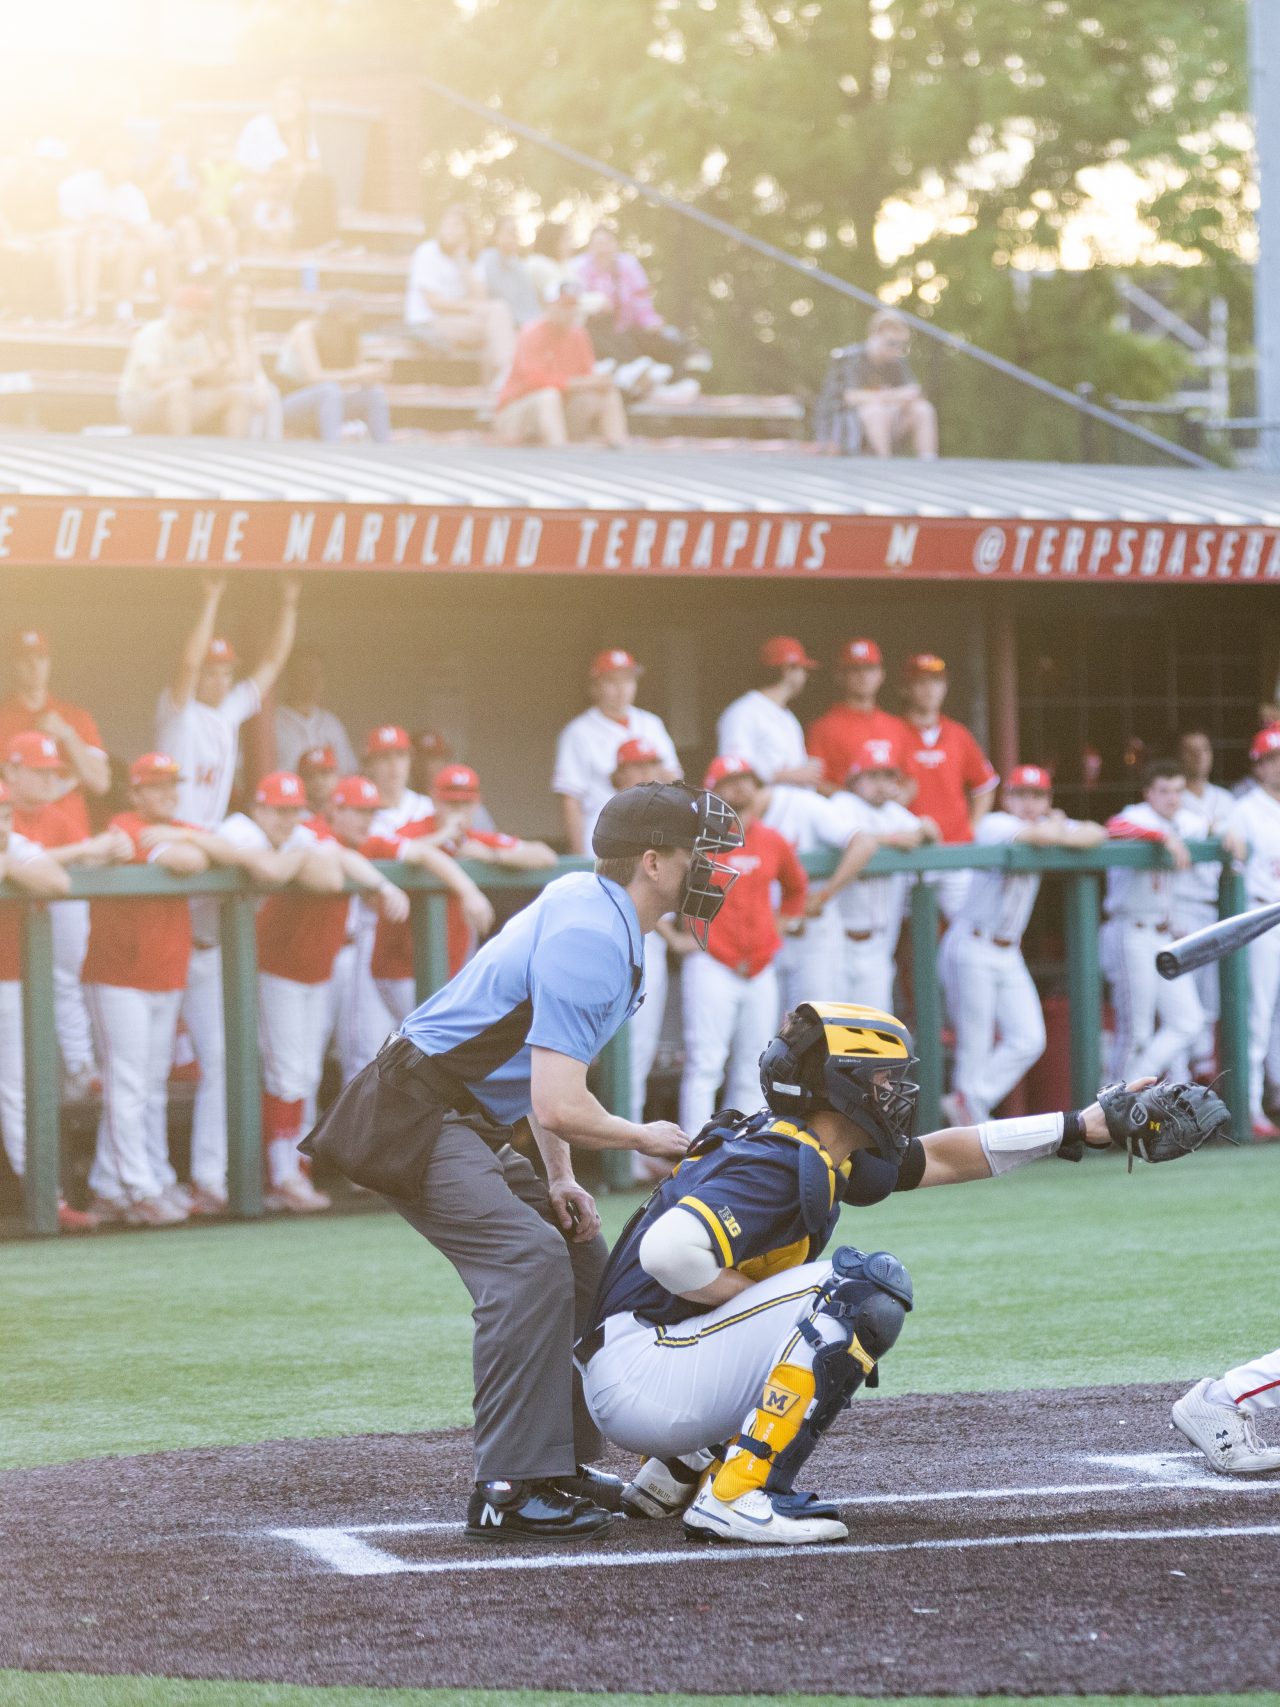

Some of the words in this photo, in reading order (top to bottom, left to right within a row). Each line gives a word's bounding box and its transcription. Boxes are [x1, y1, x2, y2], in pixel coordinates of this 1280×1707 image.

[54, 506, 117, 560] OF
[155, 510, 249, 562] THE
[283, 511, 544, 568] MARYLAND
[576, 517, 831, 570] TERRAPINS
[1150, 1120, 1161, 1132] M
[765, 1390, 789, 1411] M
[480, 1502, 504, 1527] N
